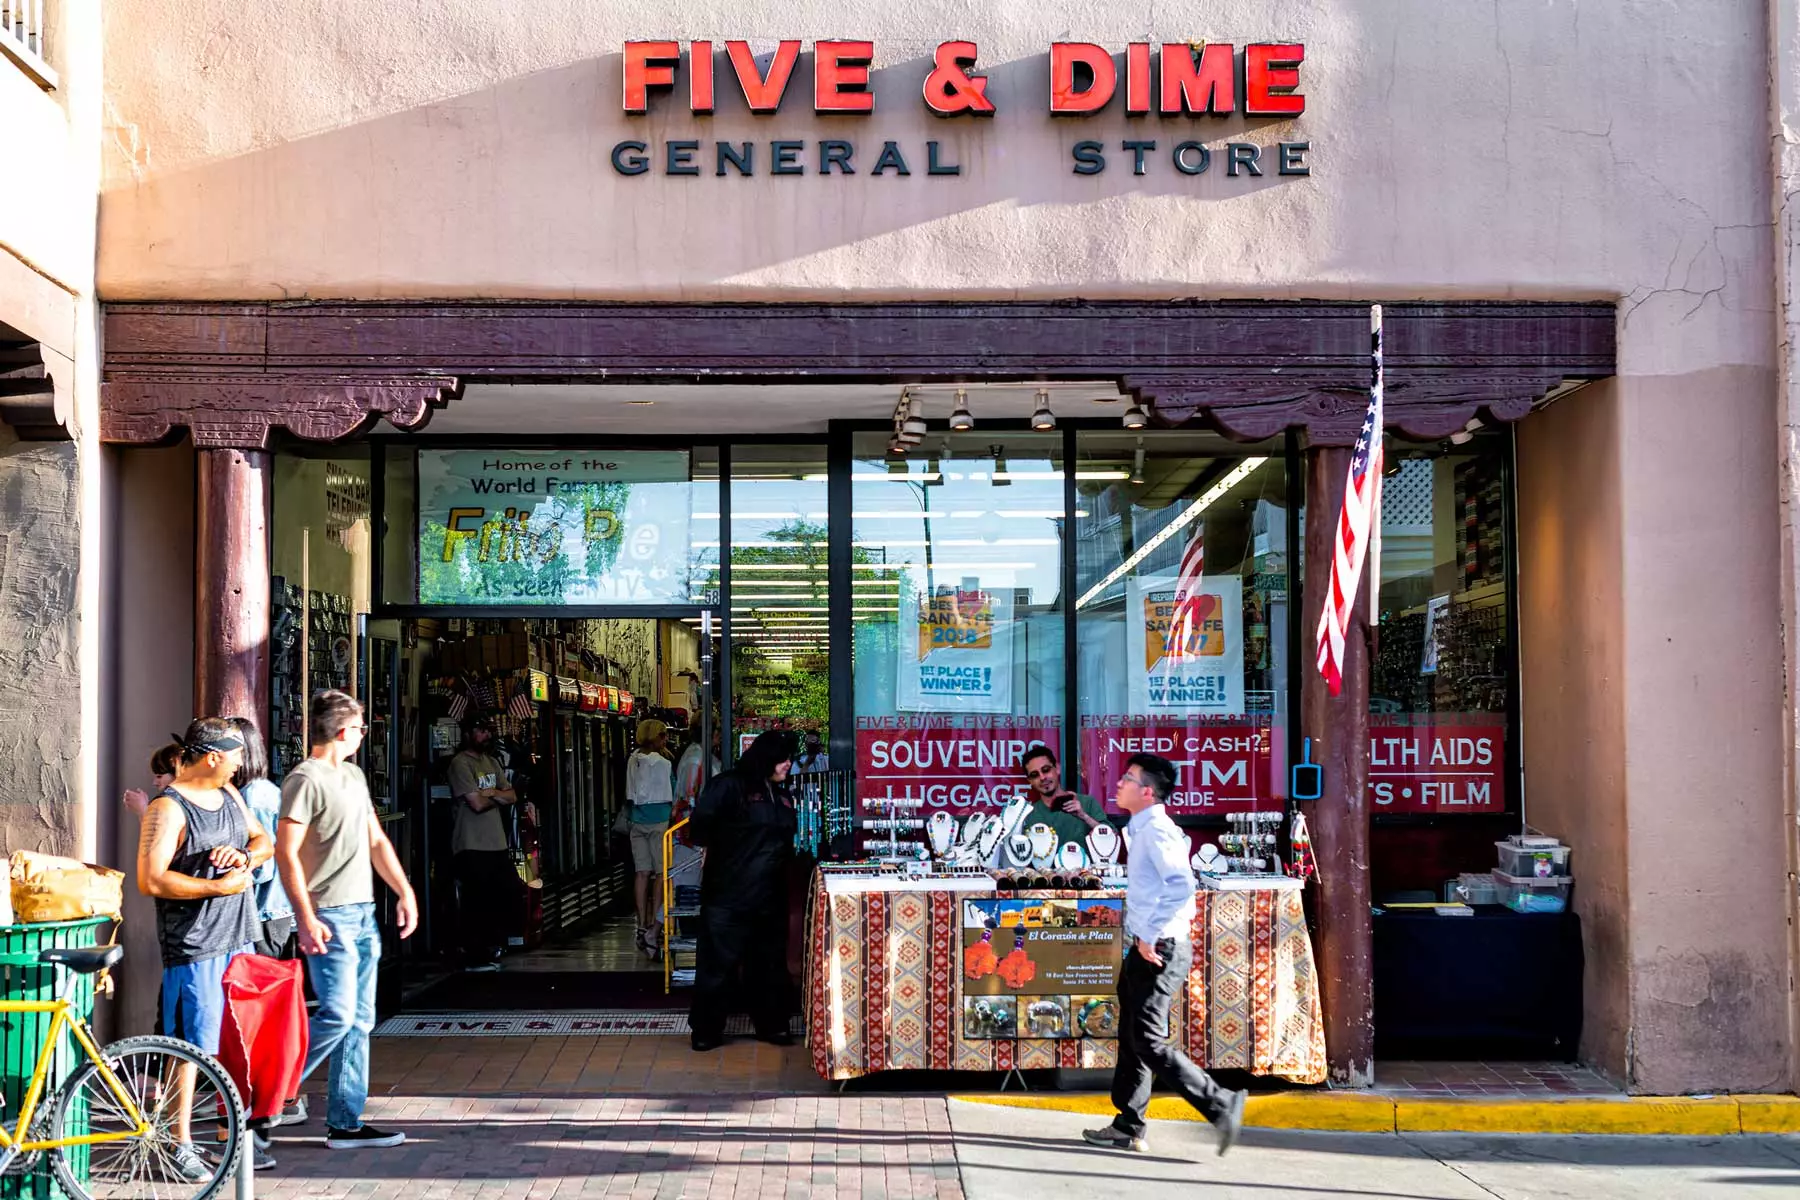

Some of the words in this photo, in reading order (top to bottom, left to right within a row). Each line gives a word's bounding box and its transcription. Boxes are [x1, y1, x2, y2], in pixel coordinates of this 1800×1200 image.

[622, 40, 875, 116] FIVE
[923, 41, 995, 117] &
[1049, 41, 1306, 118] DIME
[611, 140, 960, 177] GENERAL
[1072, 140, 1313, 177] STORE
[483, 459, 546, 471] Home
[549, 459, 569, 471] of
[582, 459, 618, 471] the
[472, 478, 535, 494] World
[705, 590, 718, 605] 58
[1204, 620, 1223, 631] FE
[932, 627, 976, 643] 2018
[937, 667, 981, 677] PLACE
[1169, 676, 1215, 687] PLACE
[1109, 738, 1173, 752] NEED
[1184, 734, 1262, 752] CASH?
[1370, 738, 1419, 765] LTH
[1430, 738, 1493, 765] AIDS
[1170, 760, 1248, 786] TM
[1164, 791, 1214, 807] NSIDE
[1421, 783, 1490, 804] FILM
[1028, 930, 1038, 940] El
[1089, 930, 1113, 939] Plata
[414, 1021, 511, 1030] FIVE
[525, 1021, 554, 1029] &
[571, 1021, 675, 1030] DIME
